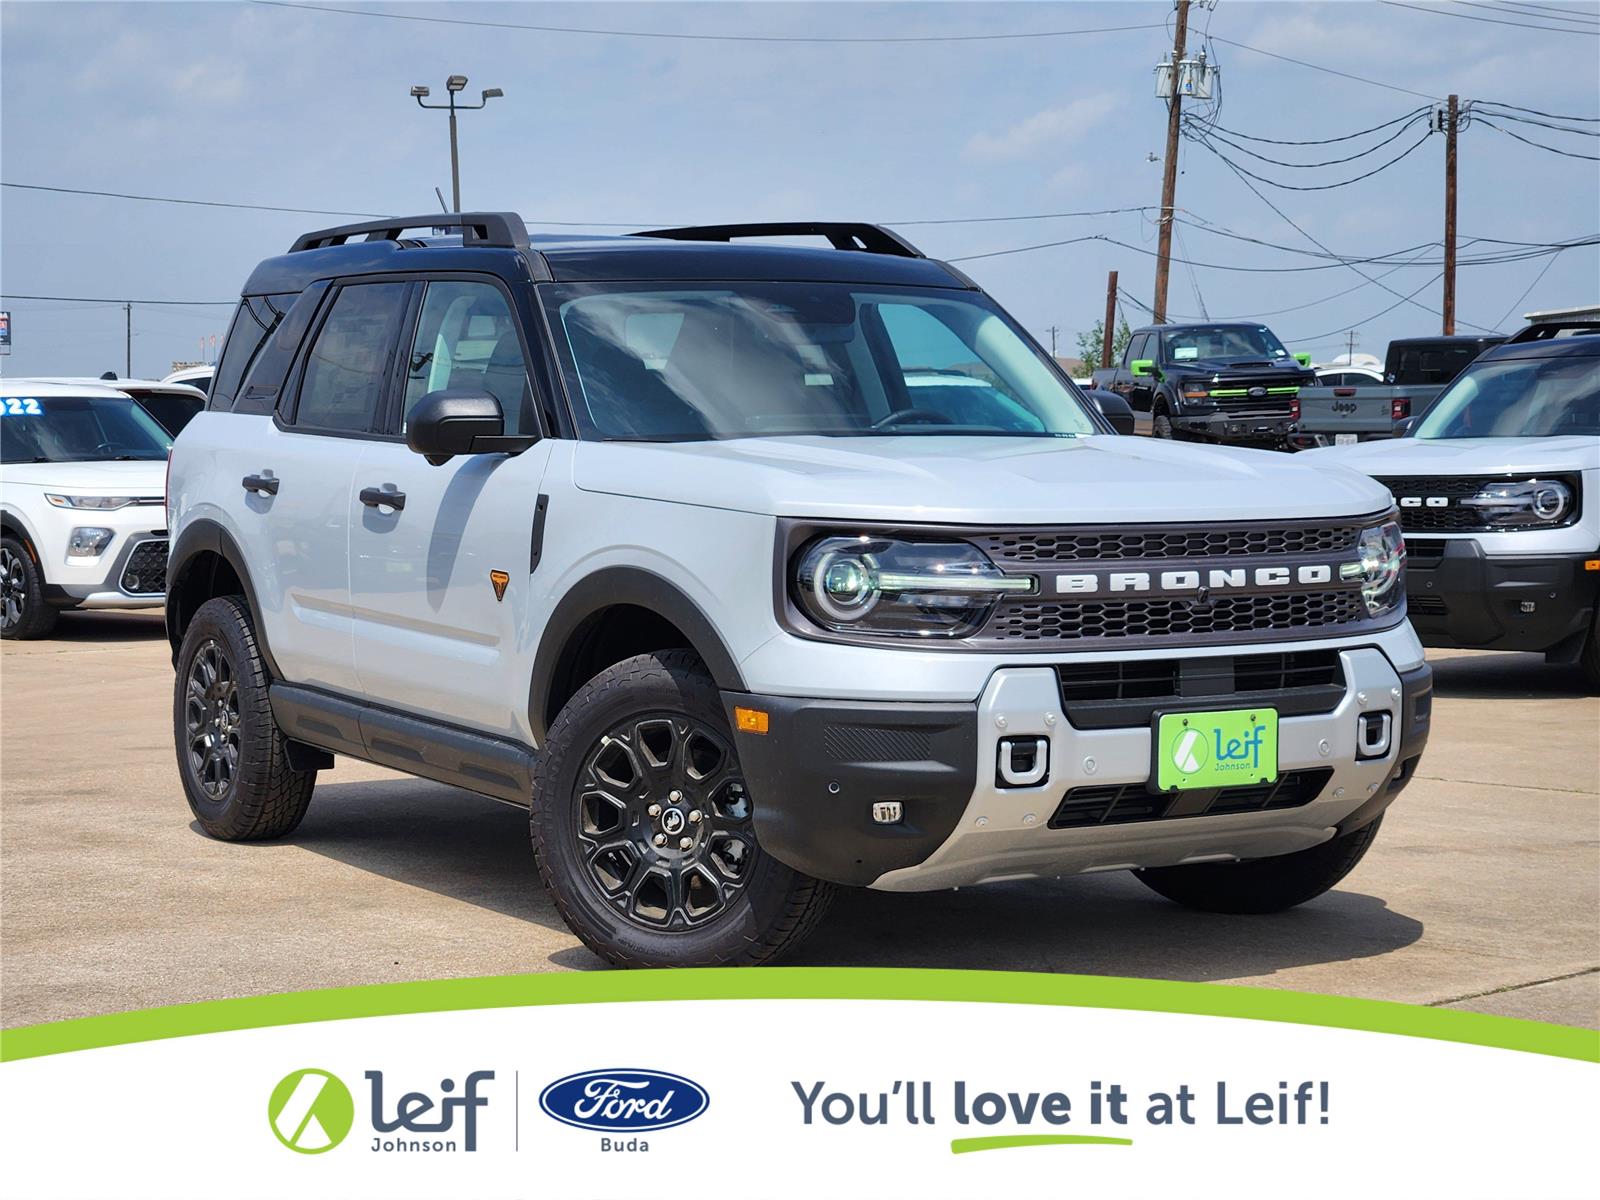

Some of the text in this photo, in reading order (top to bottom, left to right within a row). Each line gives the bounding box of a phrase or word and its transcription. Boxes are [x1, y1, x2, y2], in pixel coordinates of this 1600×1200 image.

[1331, 401, 1357, 413] Jeep
[1056, 565, 1331, 594] BRONCO
[1215, 762, 1251, 771] Johnson
